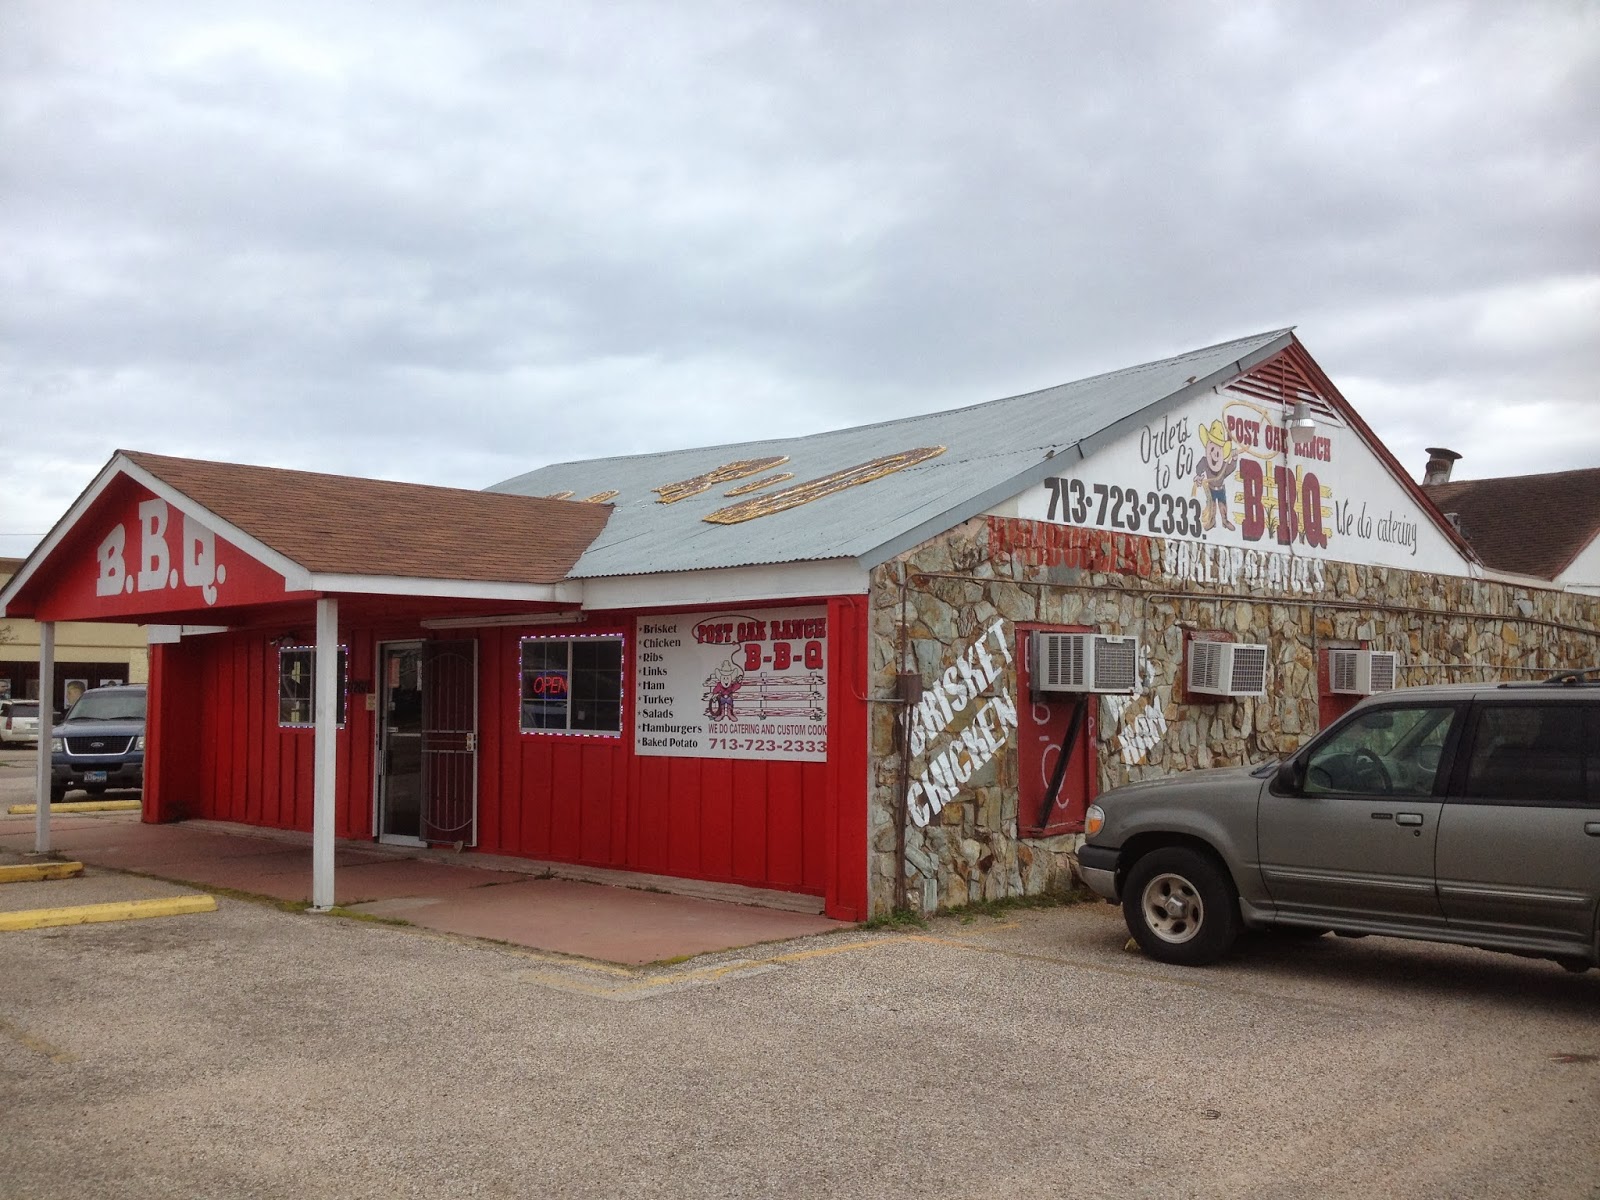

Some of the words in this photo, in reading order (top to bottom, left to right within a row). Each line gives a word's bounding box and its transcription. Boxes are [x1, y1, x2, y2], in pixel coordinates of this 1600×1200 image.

[1140, 415, 1191, 464] Orders
[1227, 415, 1260, 447] POST
[1265, 425, 1289, 455] OAK
[1155, 459, 1170, 491] to
[1240, 458, 1328, 549] BBQ
[1335, 500, 1354, 536] We
[1357, 502, 1372, 540] do
[1377, 510, 1418, 556] catering
[96, 498, 226, 606] B.B.Q.
[643, 624, 677, 634] Brisket
[697, 623, 733, 644] POST
[737, 621, 767, 643] OAK
[770, 618, 827, 641] RANCH
[643, 638, 681, 648] Chicken
[643, 652, 664, 662] Ribs
[744, 641, 824, 671] B-B-Q
[642, 666, 668, 676] Links
[533, 676, 568, 694] OPEN
[642, 680, 665, 690] Ham
[899, 618, 1013, 758] BRISKET
[642, 694, 675, 706] Turkey
[642, 708, 674, 719] Salads
[642, 722, 703, 735] Hamburgers
[708, 723, 718, 734] WE
[719, 724, 728, 734] DO
[729, 724, 760, 735] CATERING
[761, 724, 775, 735] AND
[777, 724, 806, 736] CUSTOM
[641, 737, 668, 747] Baked
[669, 738, 698, 748] Potato
[708, 738, 827, 753] 713-723-2333
[907, 687, 1018, 828] CHICKEN
